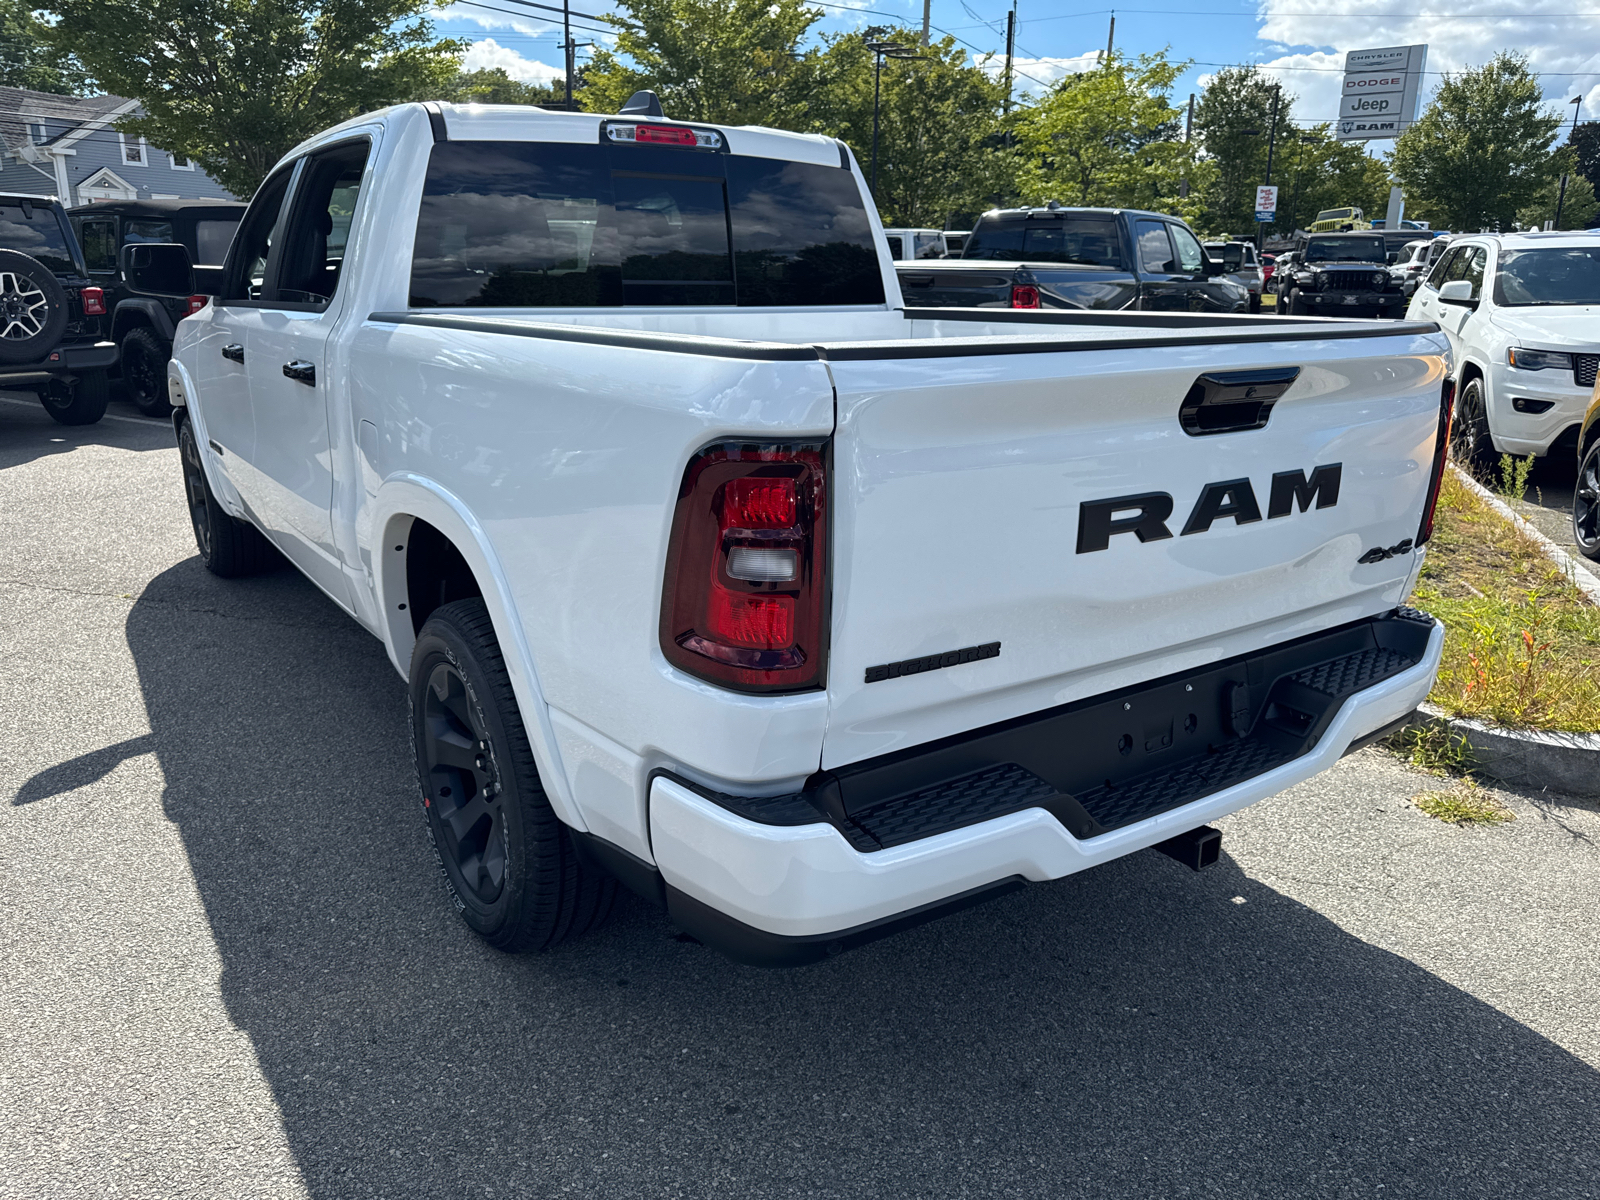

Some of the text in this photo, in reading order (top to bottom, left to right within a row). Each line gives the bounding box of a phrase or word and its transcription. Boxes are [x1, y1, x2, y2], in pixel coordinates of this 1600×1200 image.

[1350, 52, 1403, 61] CHRYSLER
[1346, 78, 1401, 88] DODGE
[1351, 98, 1389, 112] Jeep
[1356, 123, 1394, 131] RAM
[1076, 462, 1343, 554] RAM
[1357, 538, 1413, 564] 4x4
